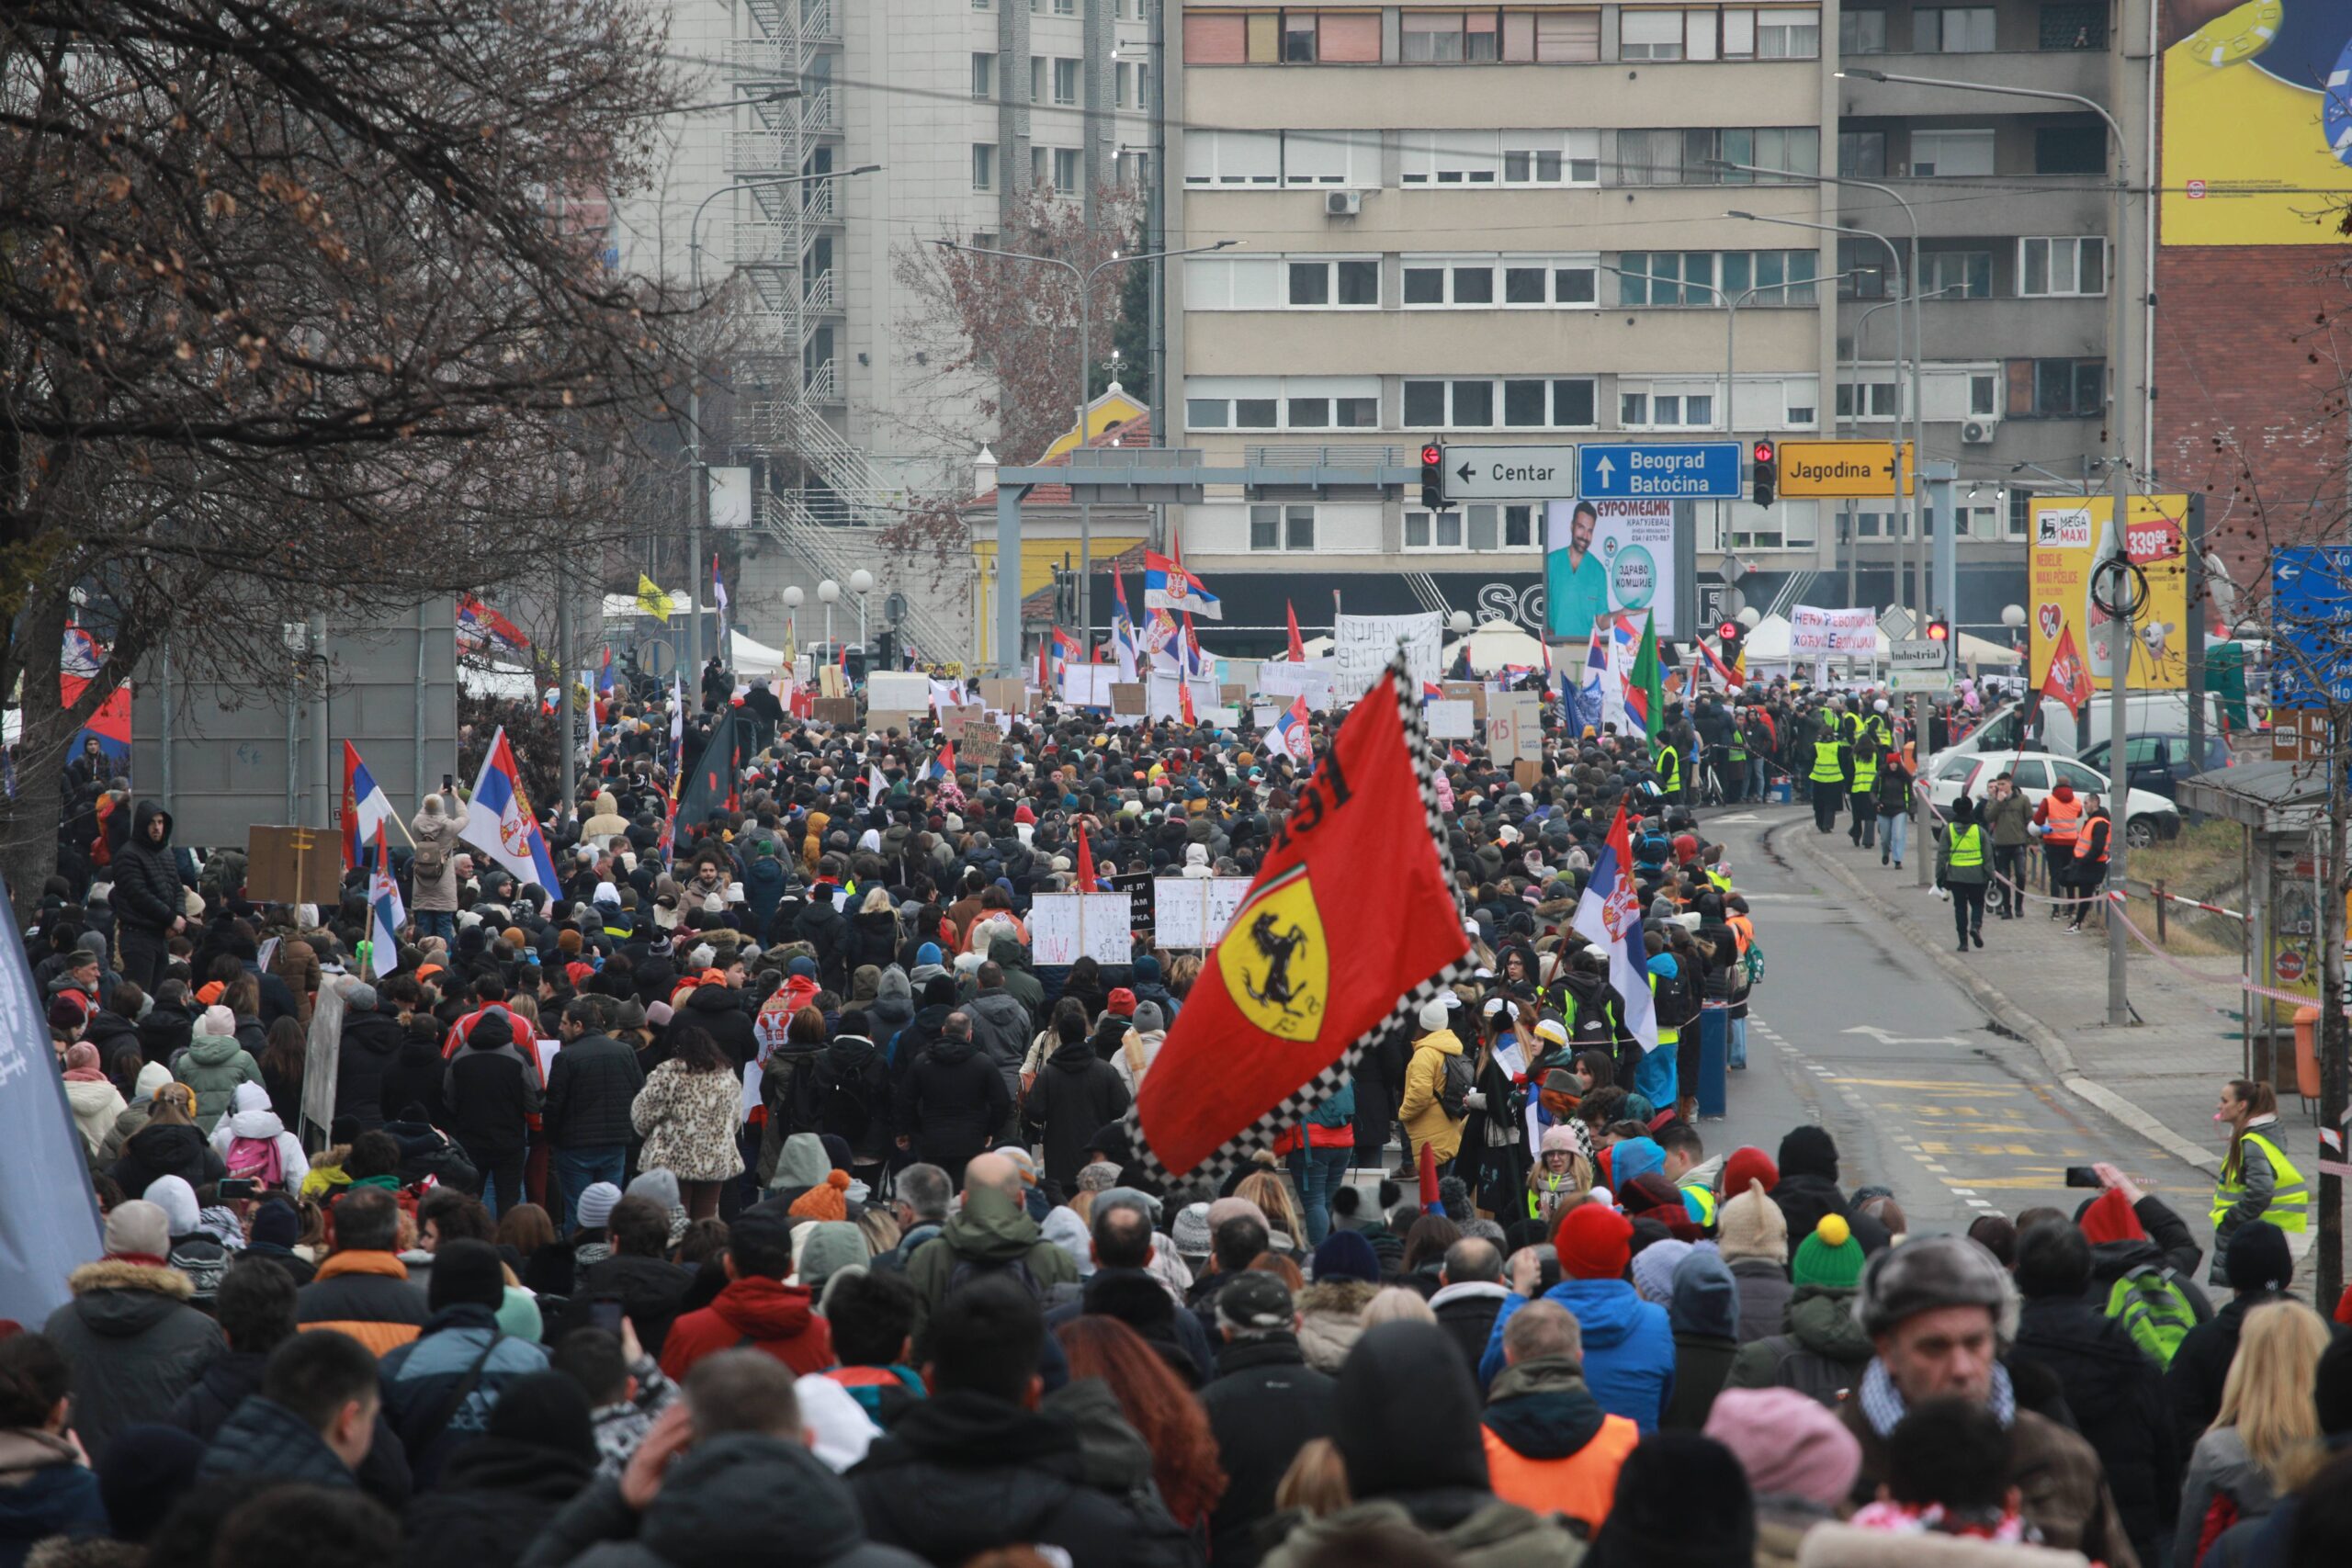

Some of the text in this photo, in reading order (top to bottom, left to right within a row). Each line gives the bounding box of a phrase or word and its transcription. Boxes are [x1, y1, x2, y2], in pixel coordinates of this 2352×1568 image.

[1630, 451, 1705, 473] Beograd
[1492, 464, 1555, 481] Centar
[1791, 461, 1871, 482] Jagodina
[1630, 475, 1710, 493] Batočina
[1626, 518, 1670, 527] КРАГУЈЕВАЦ
[2060, 516, 2086, 527] MEGA
[2060, 530, 2087, 542] MAXI
[1619, 565, 1649, 575] ЗДРАВО
[1615, 578, 1653, 588] КОМШИЈЕ
[1892, 648, 1940, 660] Industrial
[1491, 719, 1510, 740] 15
